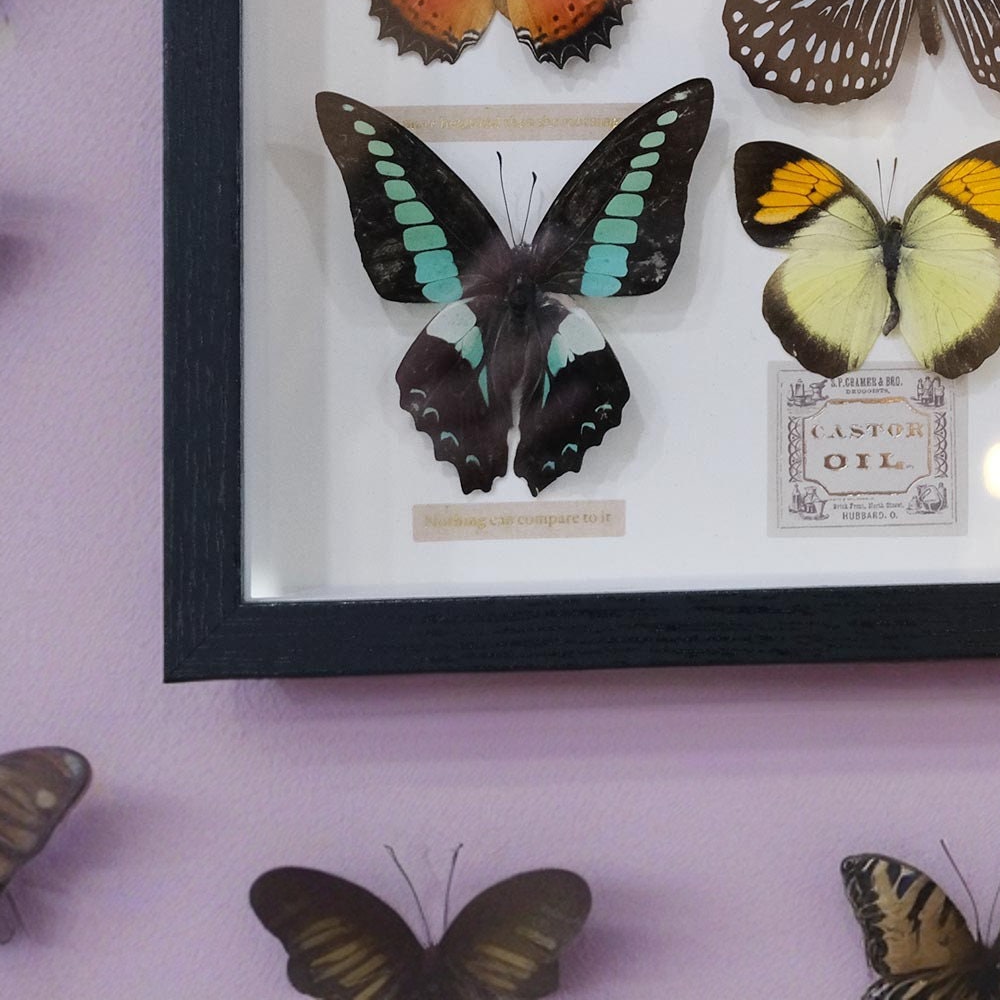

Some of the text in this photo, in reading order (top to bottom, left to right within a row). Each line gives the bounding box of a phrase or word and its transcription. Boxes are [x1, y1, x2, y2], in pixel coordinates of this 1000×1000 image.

[810, 422, 925, 440] CASTOR
[516, 512, 580, 529] compare
[583, 511, 598, 524] to
[601, 510, 612, 524] it
